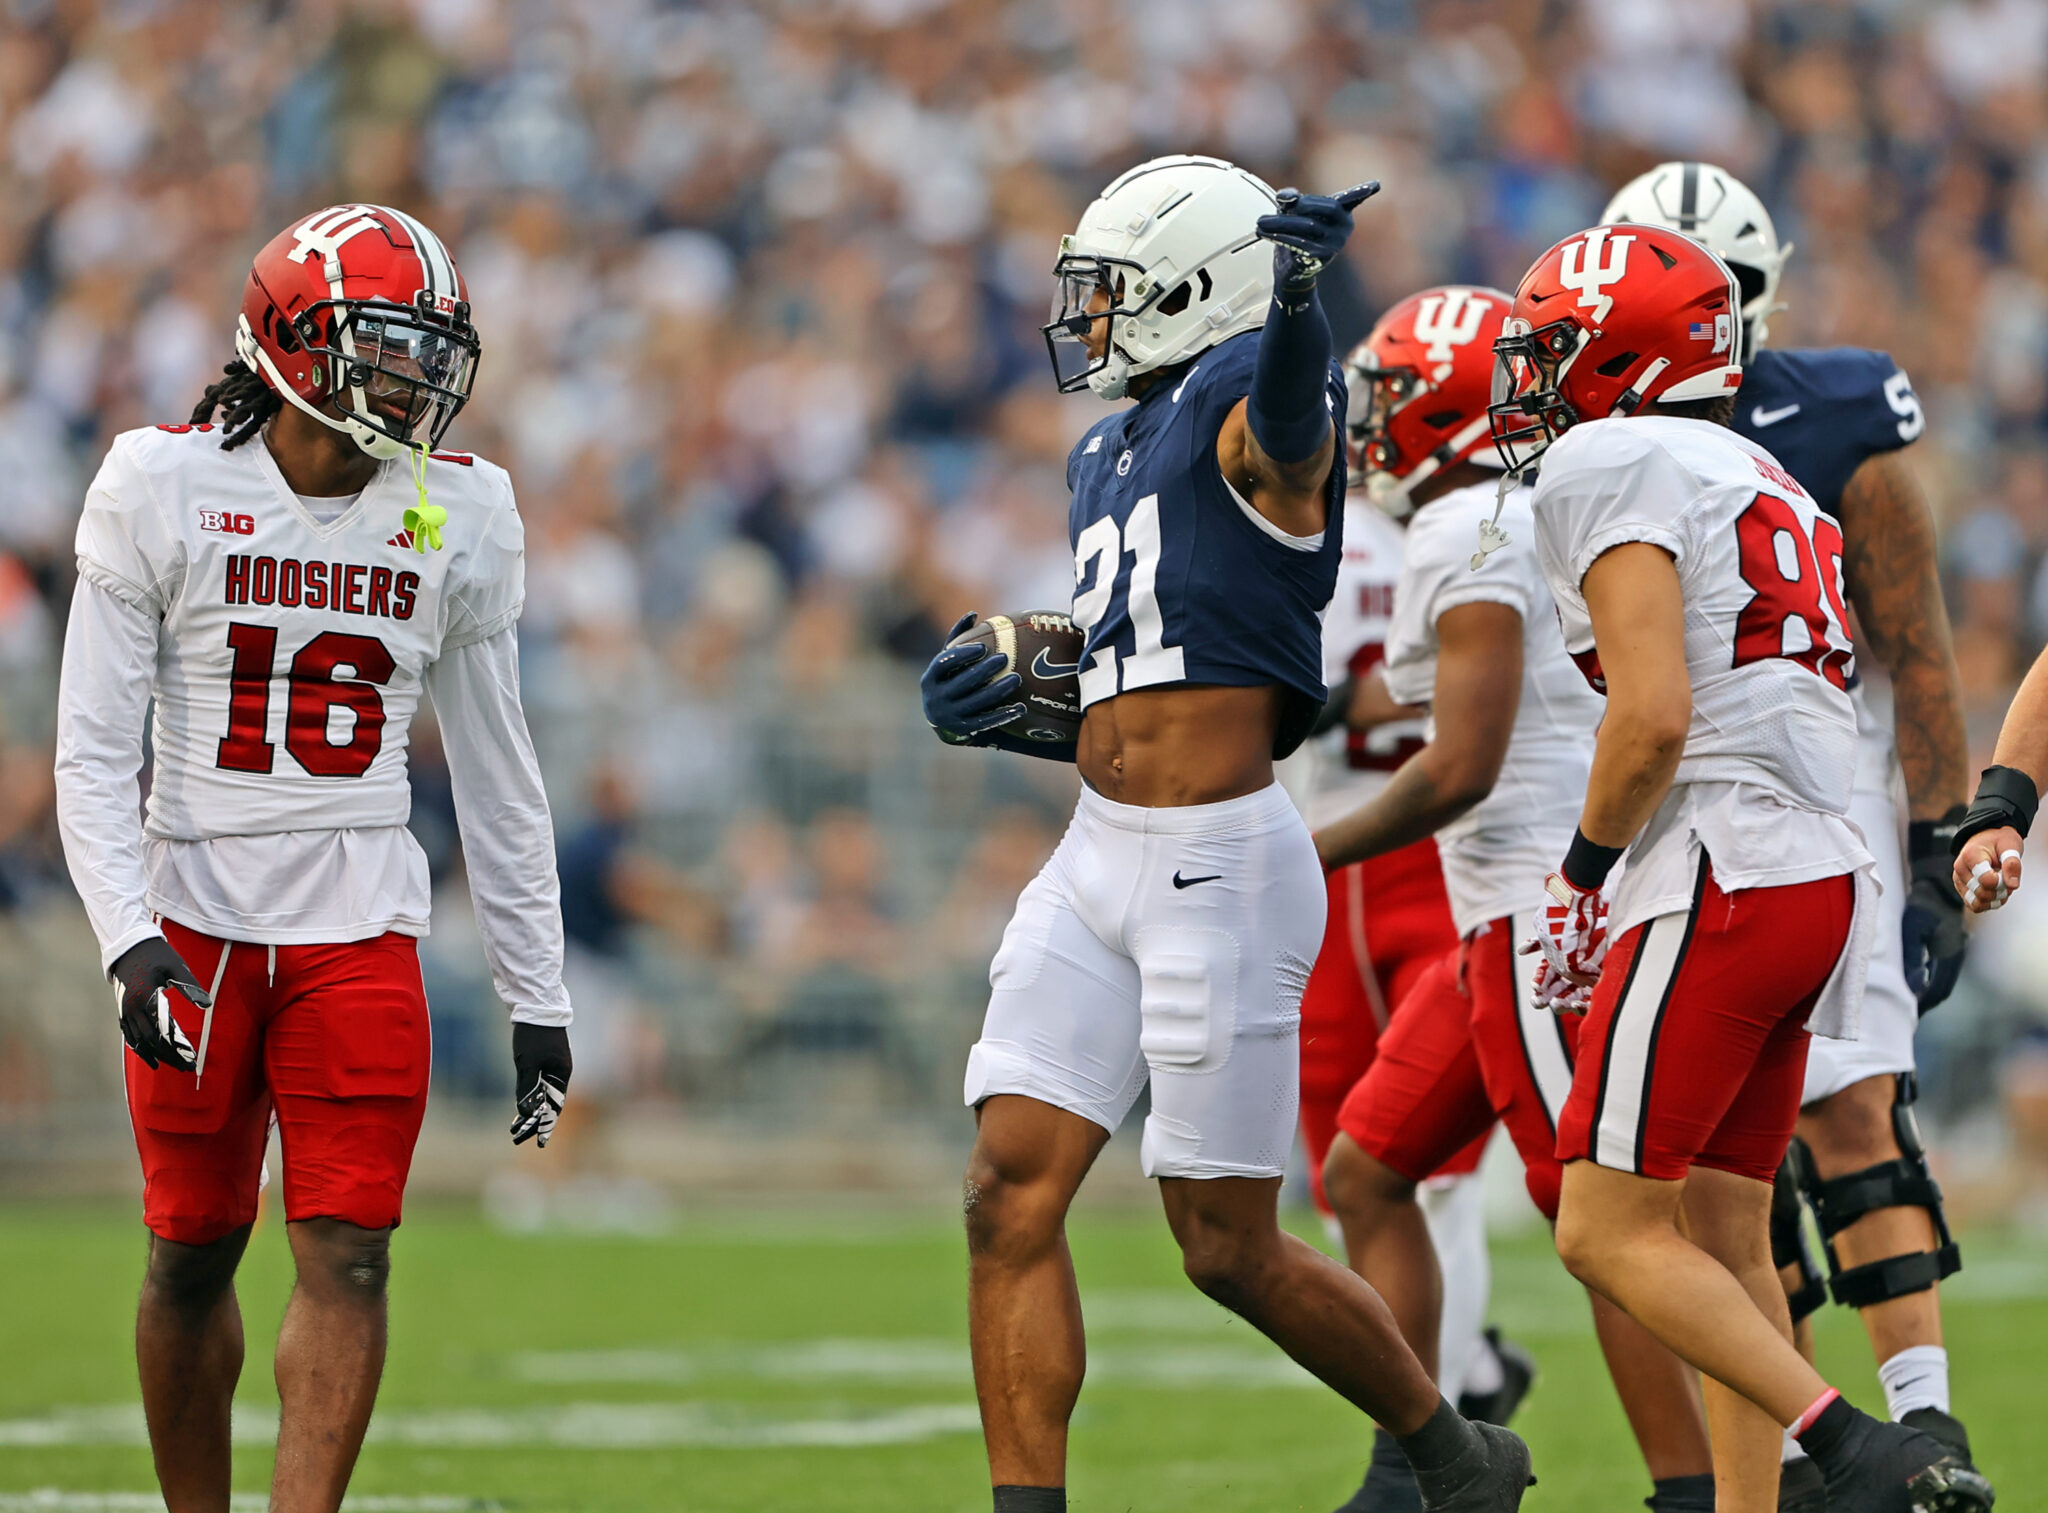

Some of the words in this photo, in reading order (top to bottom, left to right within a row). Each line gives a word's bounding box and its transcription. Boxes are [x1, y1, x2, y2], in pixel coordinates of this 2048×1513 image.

[434, 296, 454, 314] EO
[225, 555, 420, 621] HOOSIERS
[1072, 493, 1187, 713] 21
[216, 621, 397, 777] 16
